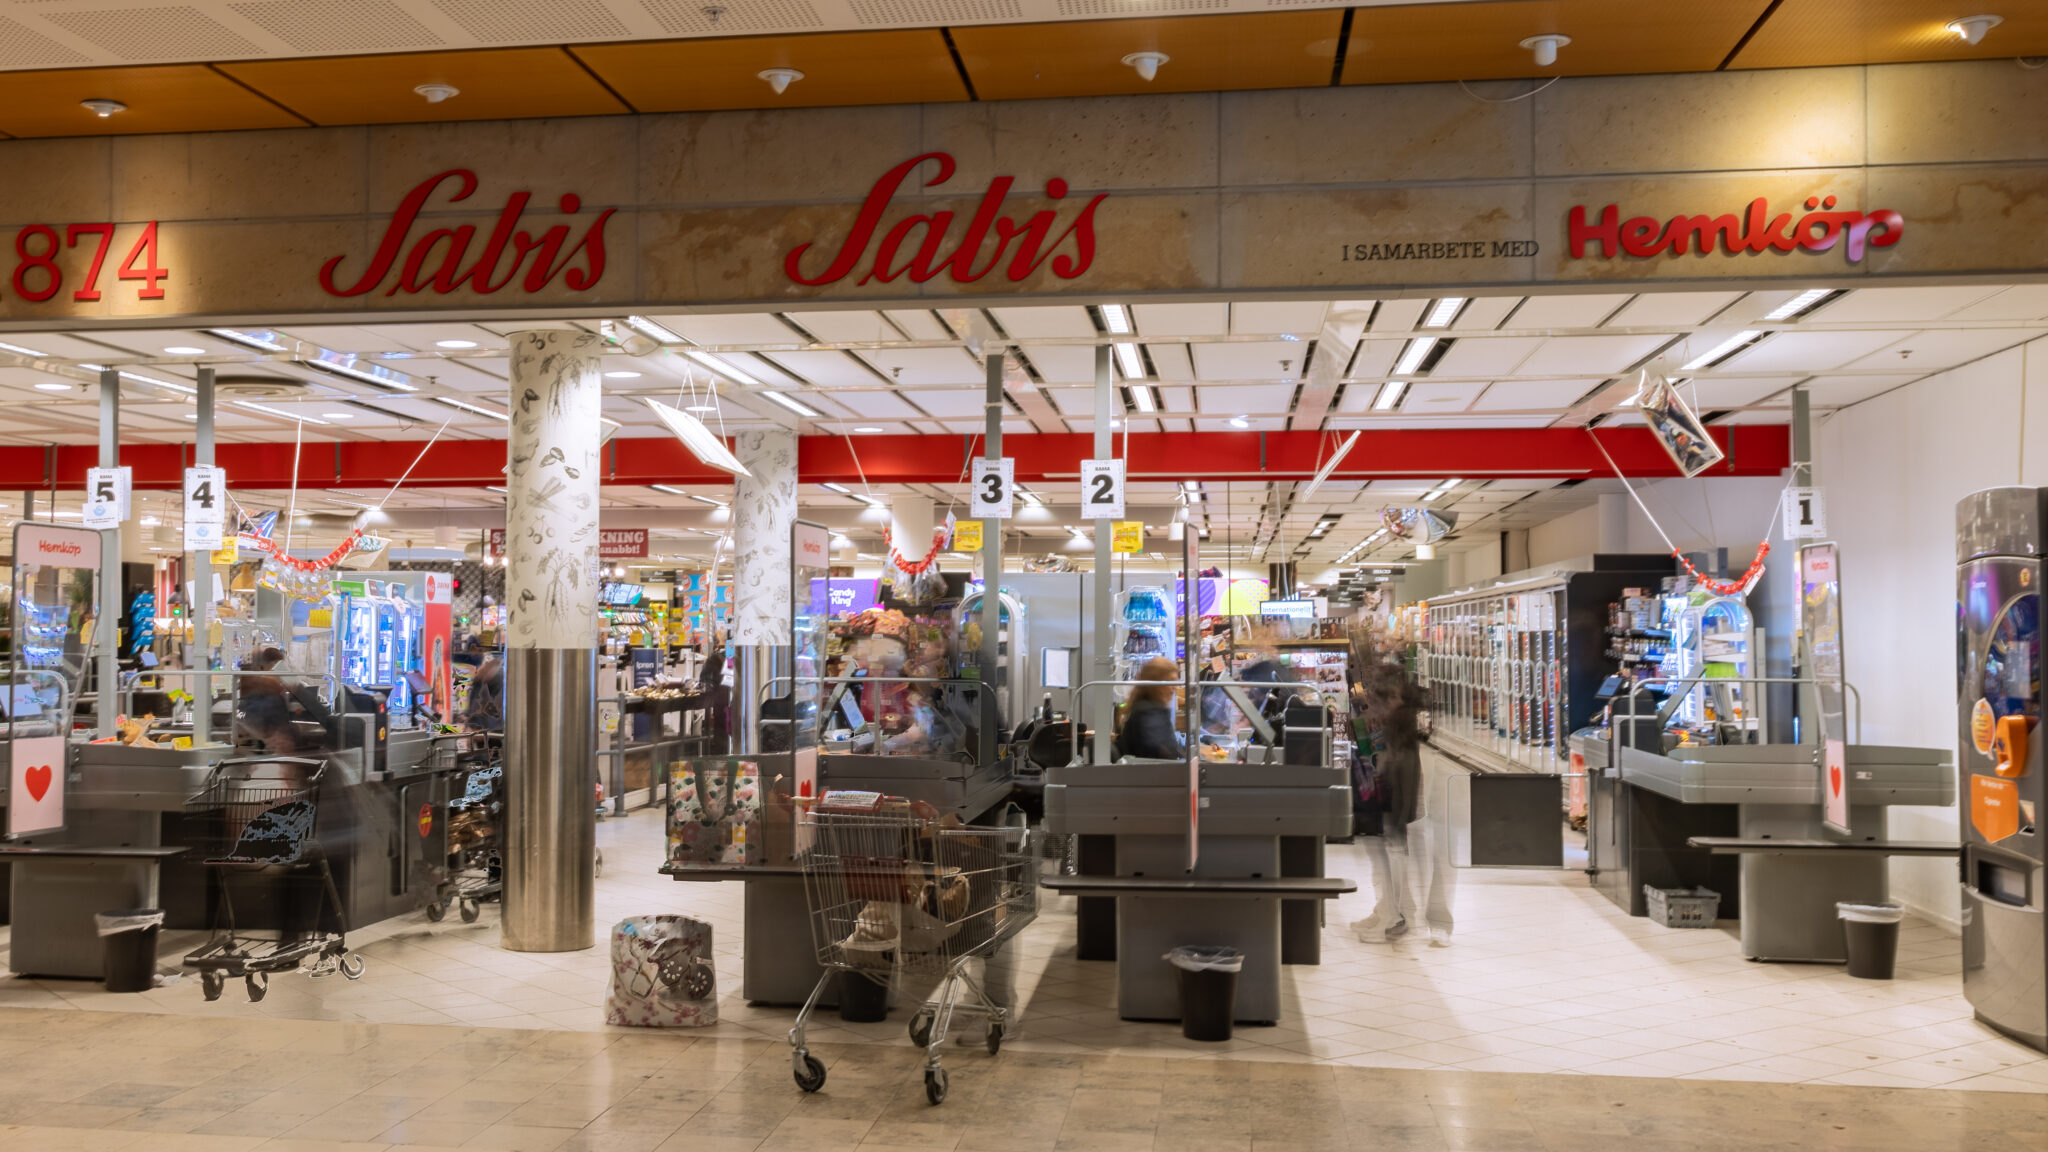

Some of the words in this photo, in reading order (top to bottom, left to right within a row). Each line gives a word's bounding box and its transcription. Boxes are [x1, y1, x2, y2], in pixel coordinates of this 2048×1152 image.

[319, 169, 617, 297] Sabis
[784, 151, 1110, 287] Sabis
[1569, 195, 1905, 264] Hemköp
[1342, 244, 1349, 262] I
[1354, 241, 1485, 261] SAMARBETE
[1491, 240, 1540, 258] MED
[95, 481, 116, 503] 5
[192, 481, 215, 509] 4
[980, 473, 1004, 504] 3
[1090, 474, 1115, 505] 2
[1798, 499, 1814, 526] 1
[38, 539, 82, 558] Hemköp
[831, 596, 852, 608] King
